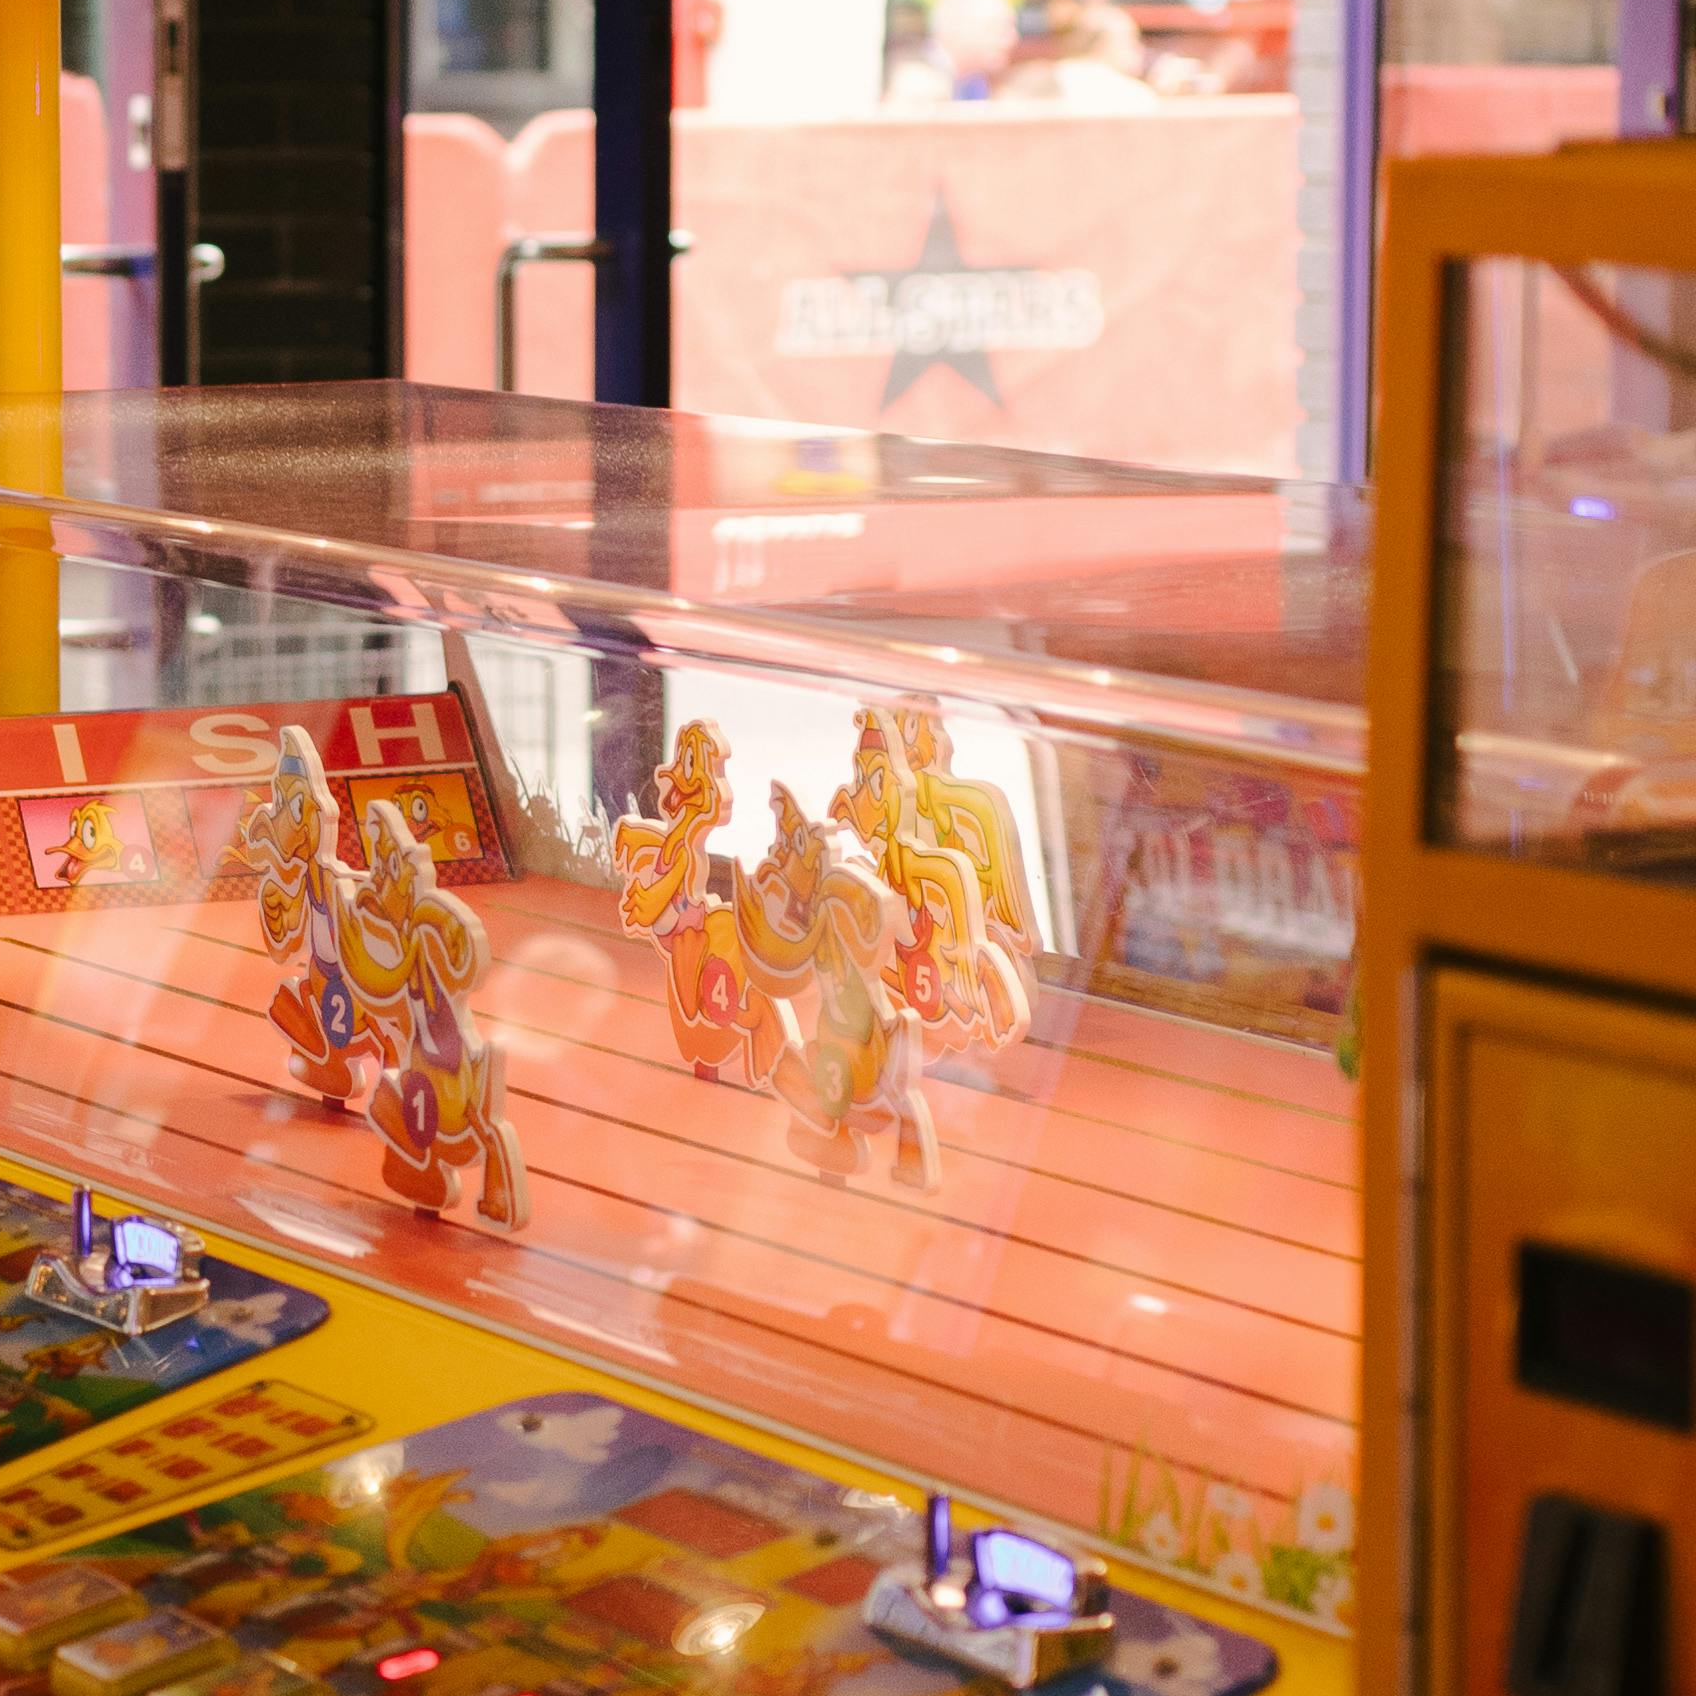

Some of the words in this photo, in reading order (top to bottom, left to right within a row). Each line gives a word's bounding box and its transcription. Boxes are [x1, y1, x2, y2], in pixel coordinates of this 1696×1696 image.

[710, 974, 730, 1012] 4
[914, 965, 932, 1003] 5
[330, 993, 347, 1034] 2
[411, 1089, 426, 1132] 1
